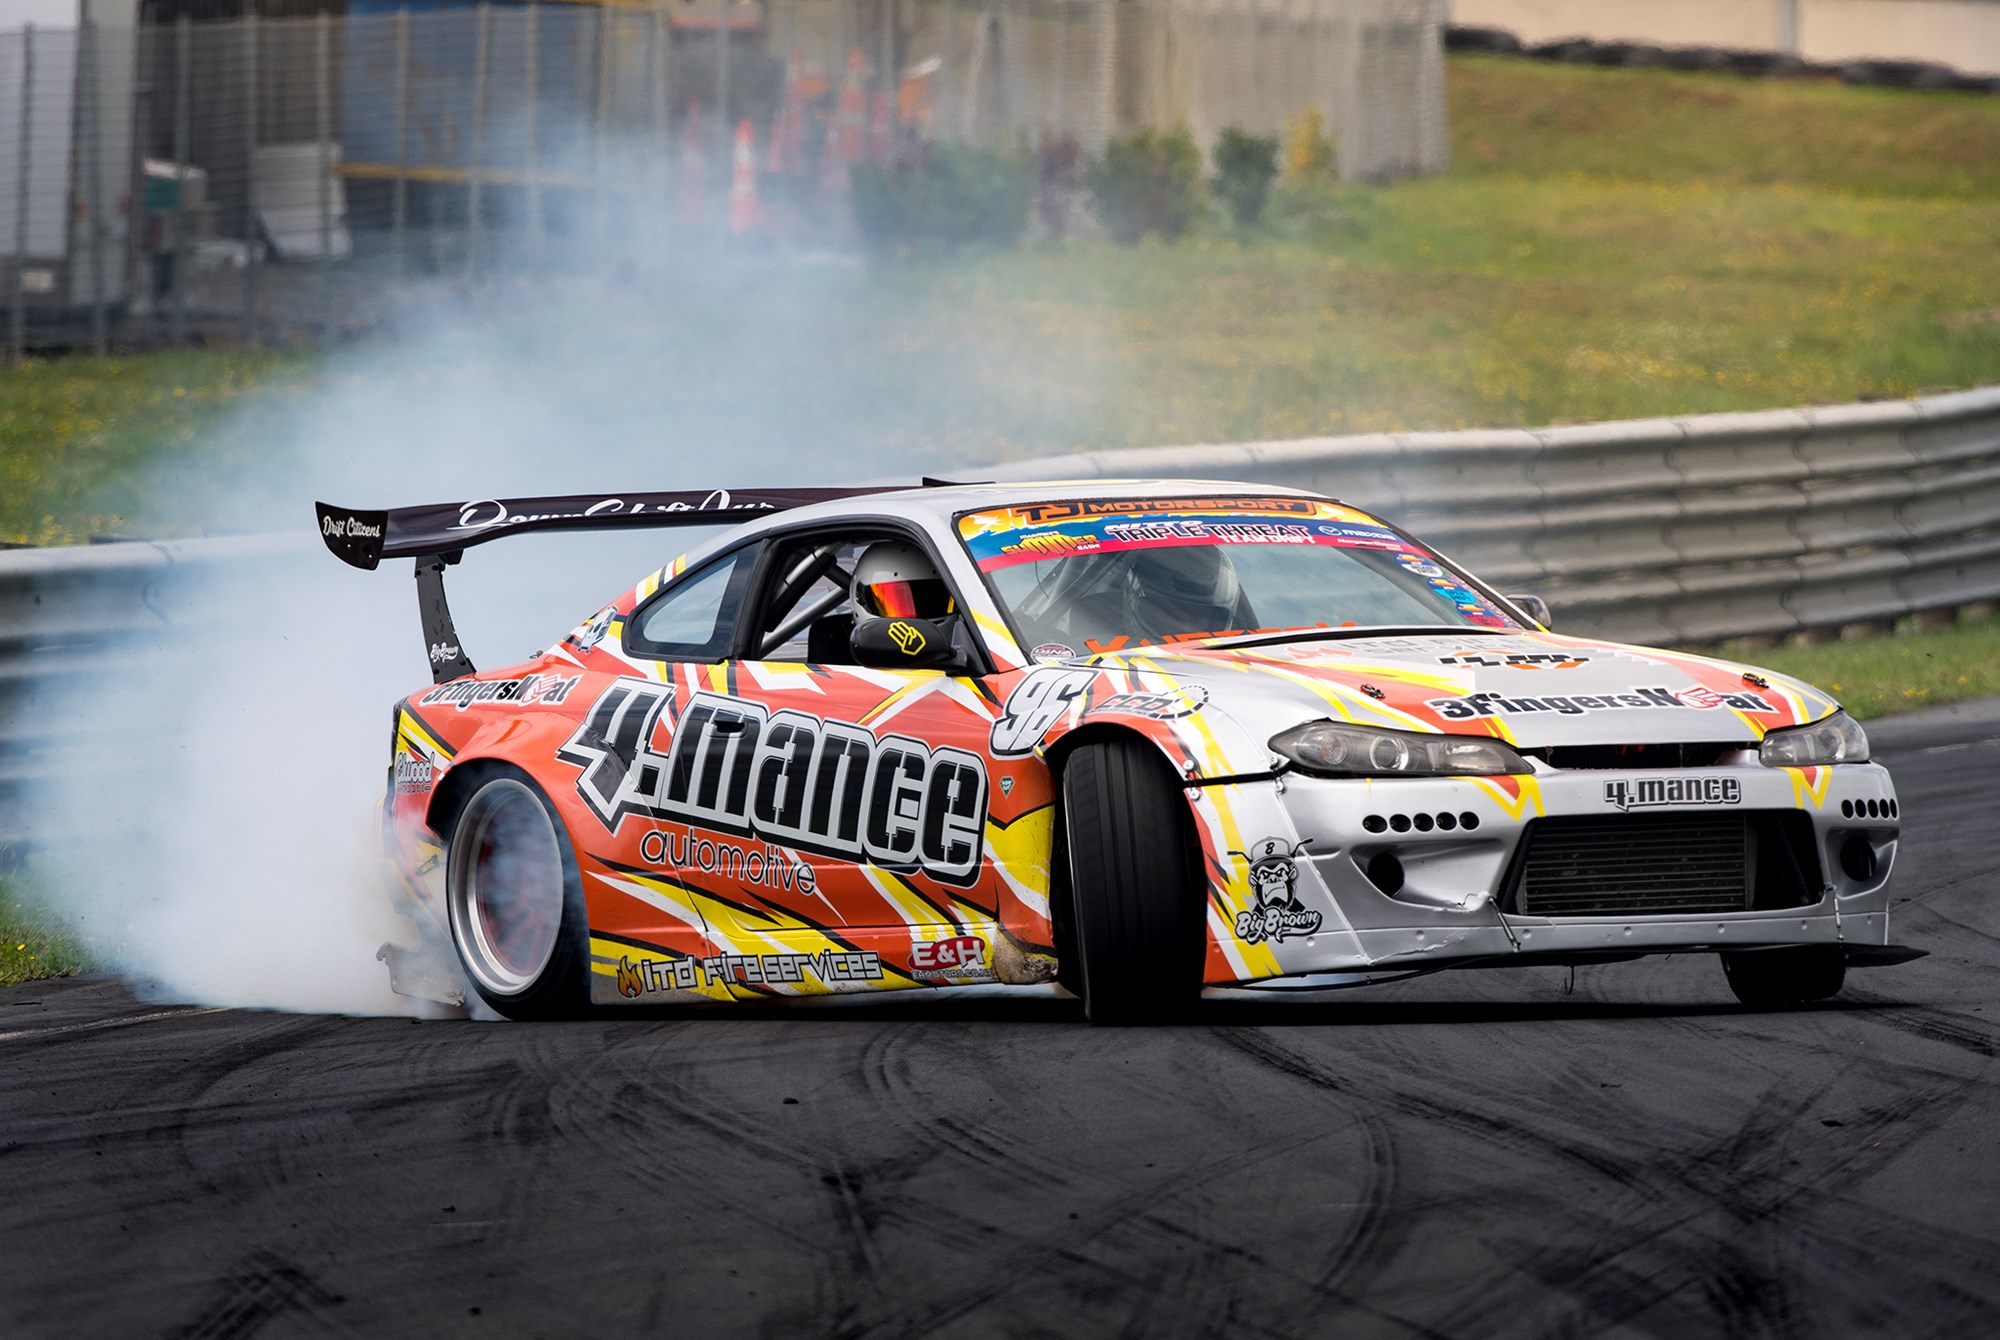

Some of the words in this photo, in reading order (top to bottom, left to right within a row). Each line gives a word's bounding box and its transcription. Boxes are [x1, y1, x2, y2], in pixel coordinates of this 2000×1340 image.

[1089, 499, 1295, 513] MOTORSPORT
[323, 515, 346, 538] Drift
[346, 516, 381, 538] Citizens
[1107, 525, 1209, 543] TRIPLE
[1201, 523, 1309, 540] THREAT
[1000, 533, 1100, 556] SUMMER
[640, 827, 817, 896] automotive
[911, 939, 985, 968] E&H
